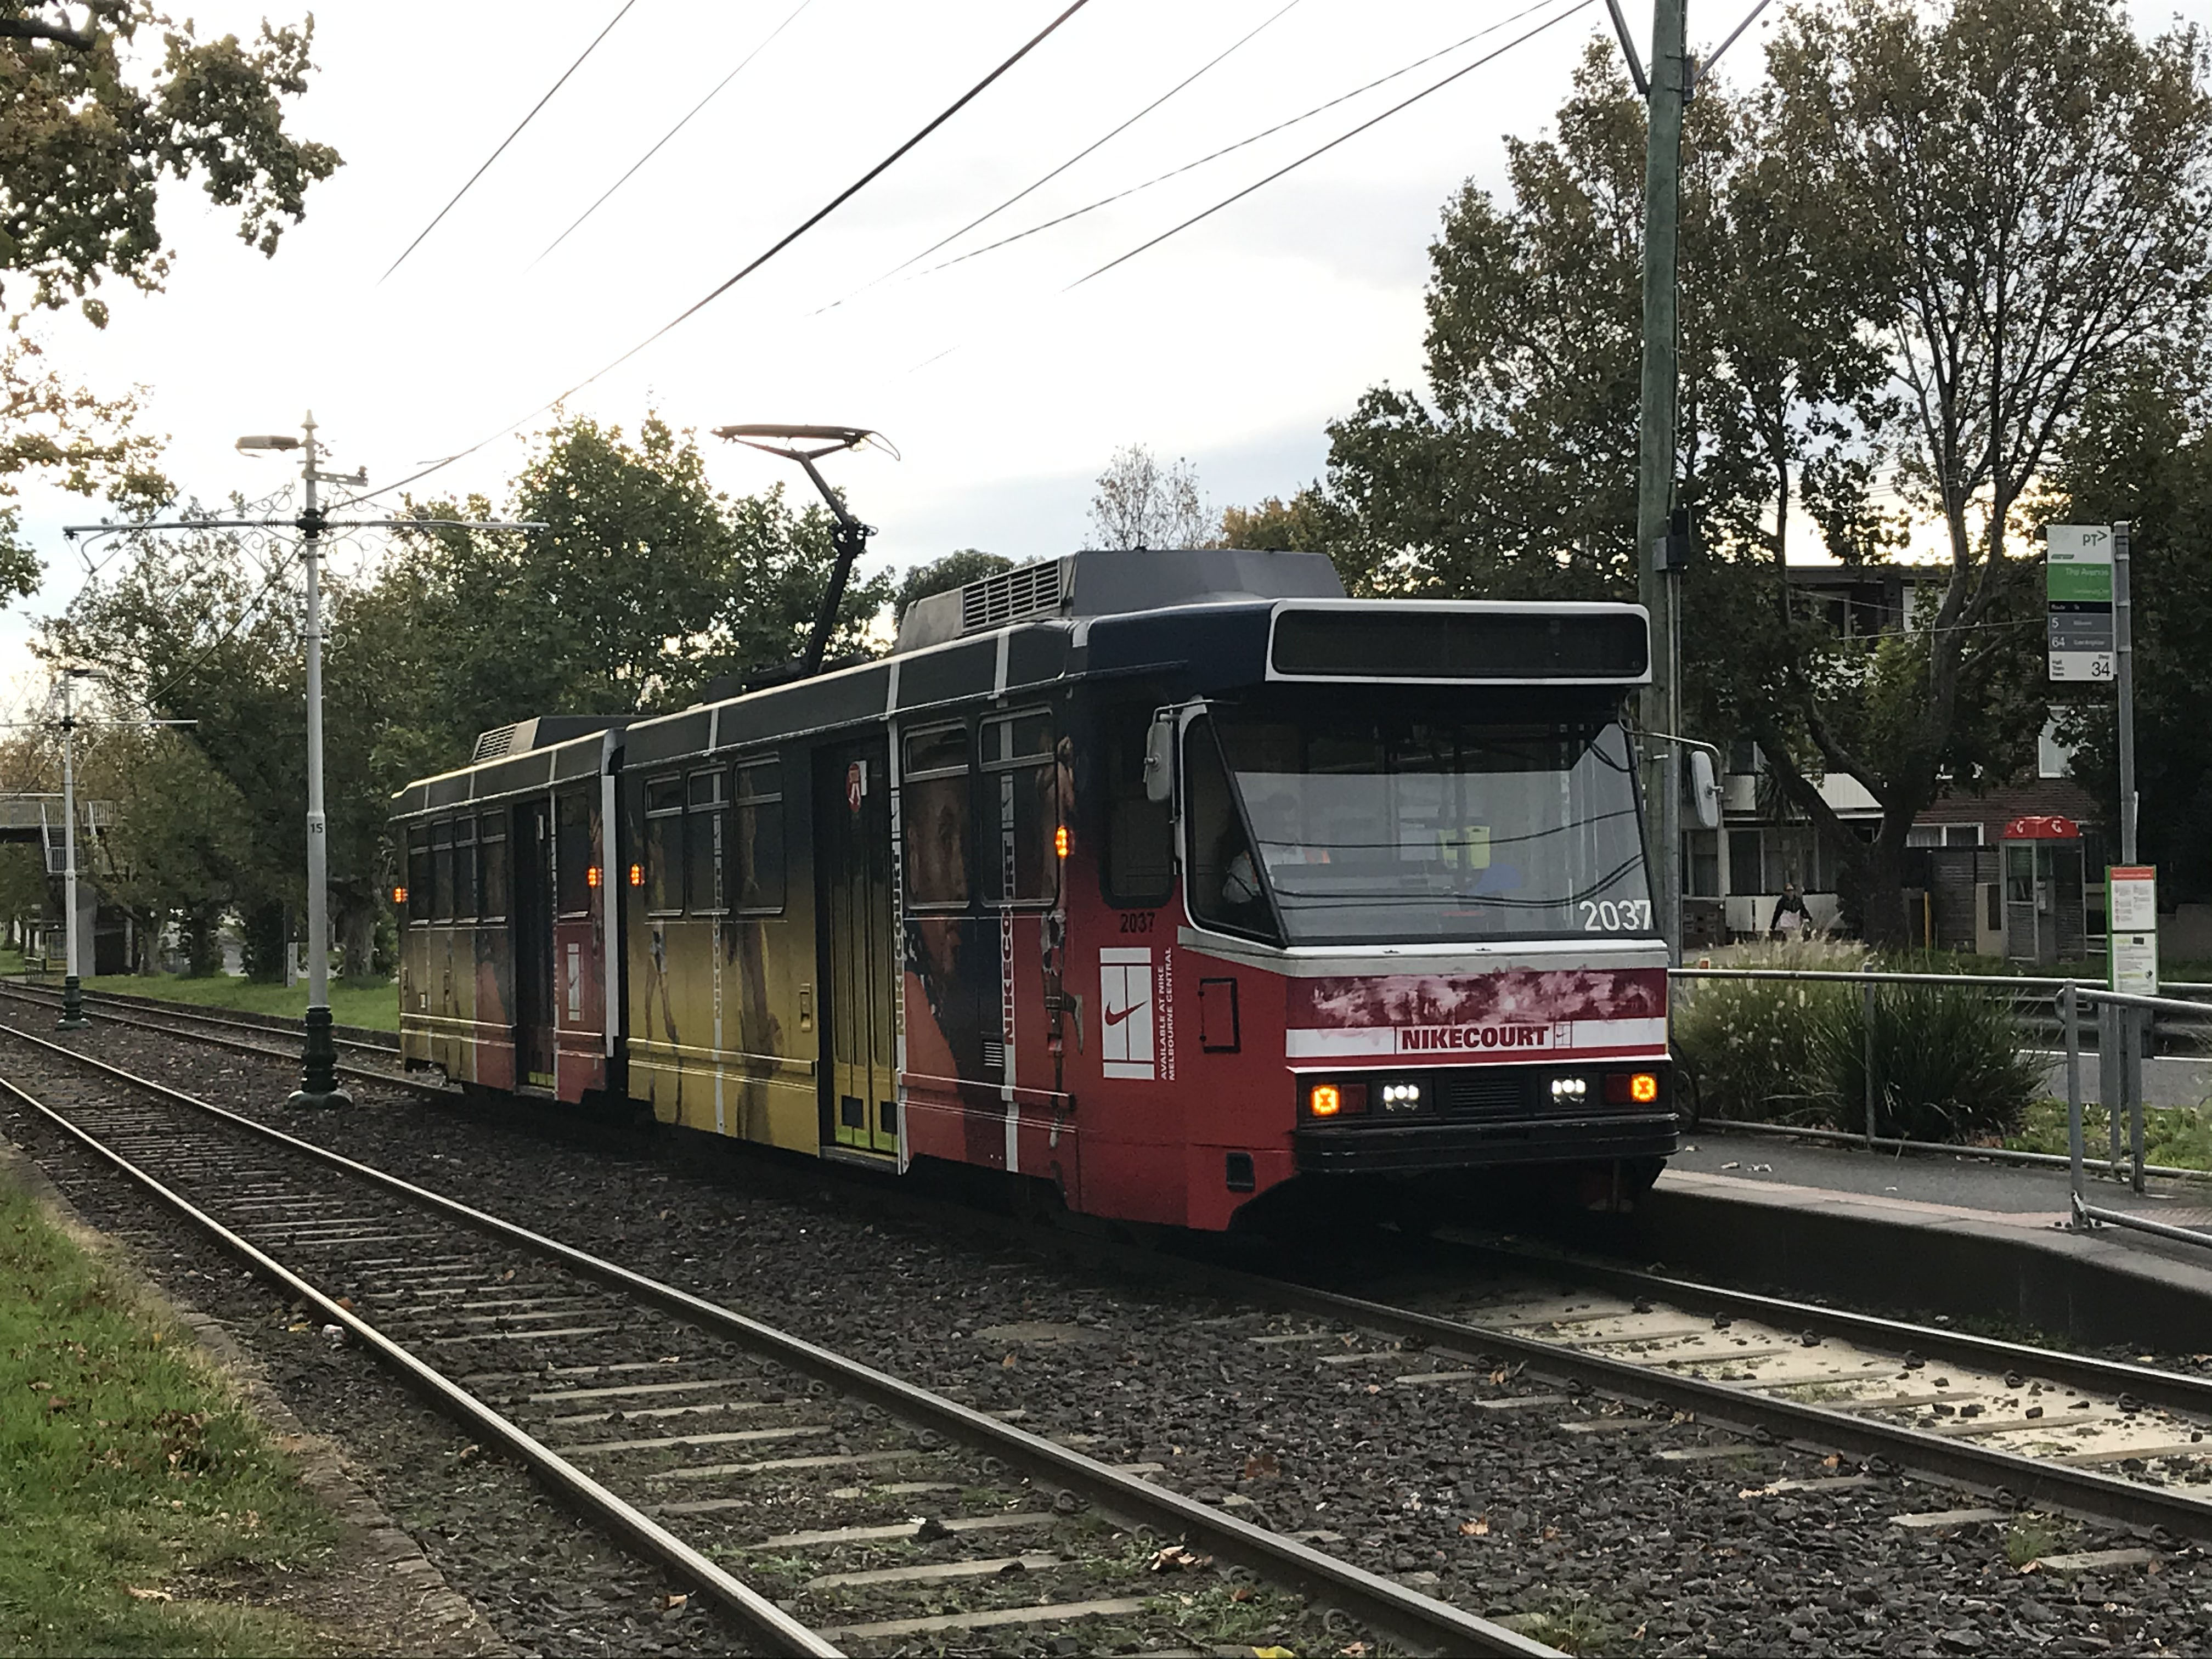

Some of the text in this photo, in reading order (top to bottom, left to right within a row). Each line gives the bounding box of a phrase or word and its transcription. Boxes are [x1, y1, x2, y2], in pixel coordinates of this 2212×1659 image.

[2052, 617, 2059, 628] 5
[2052, 637, 2065, 647] 64
[2092, 662, 2111, 676] 34
[311, 823, 323, 833] 15
[1121, 912, 1155, 933] 2037
[1579, 900, 1651, 931] 2037
[893, 849, 904, 1035] NIKECOURT
[1159, 998, 1166, 1012] AT
[1167, 1006, 1175, 1080] MELBOURNE
[1402, 1026, 1549, 1049] NIKECOURT
